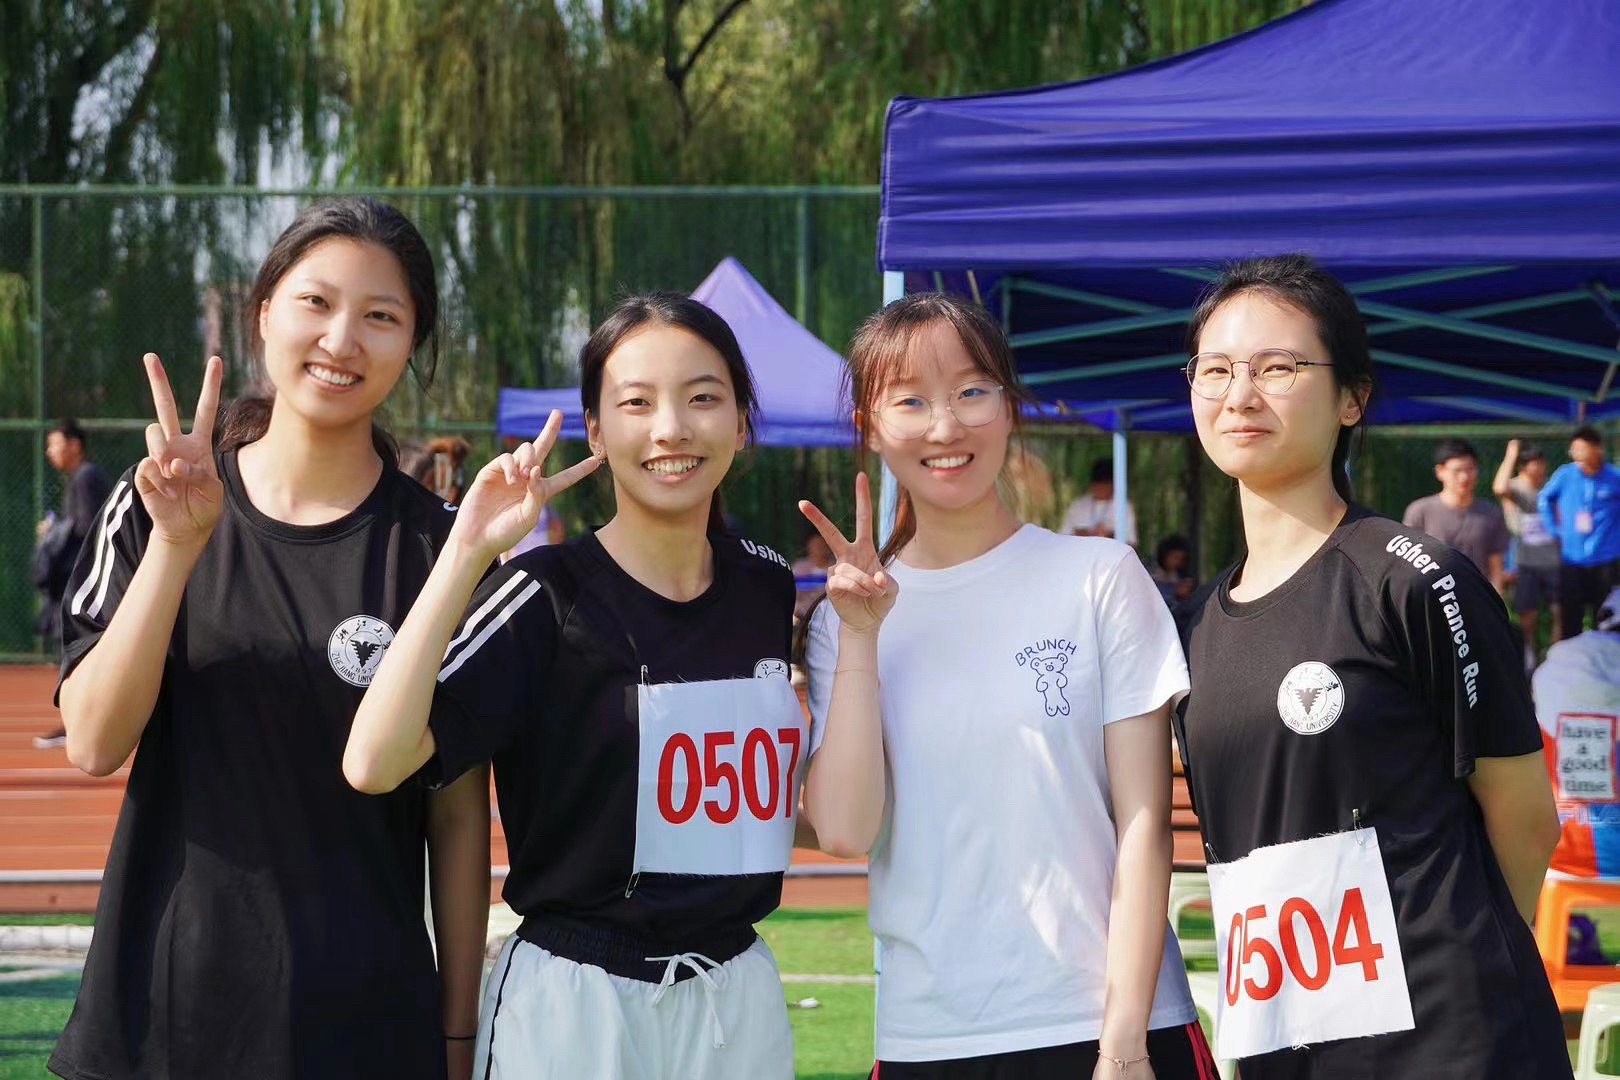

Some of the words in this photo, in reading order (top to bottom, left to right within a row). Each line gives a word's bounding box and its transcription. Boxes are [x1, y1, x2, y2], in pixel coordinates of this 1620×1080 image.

[1015, 638, 1077, 667] BRUNCH
[1386, 535, 1440, 574] Usher
[1432, 574, 1470, 659] Prance
[1462, 661, 1480, 709] Run
[1306, 701, 1340, 731] UNIVERSITY
[657, 728, 801, 825] 0507
[1561, 754, 1607, 773] good
[1226, 887, 1384, 1006] 0504
